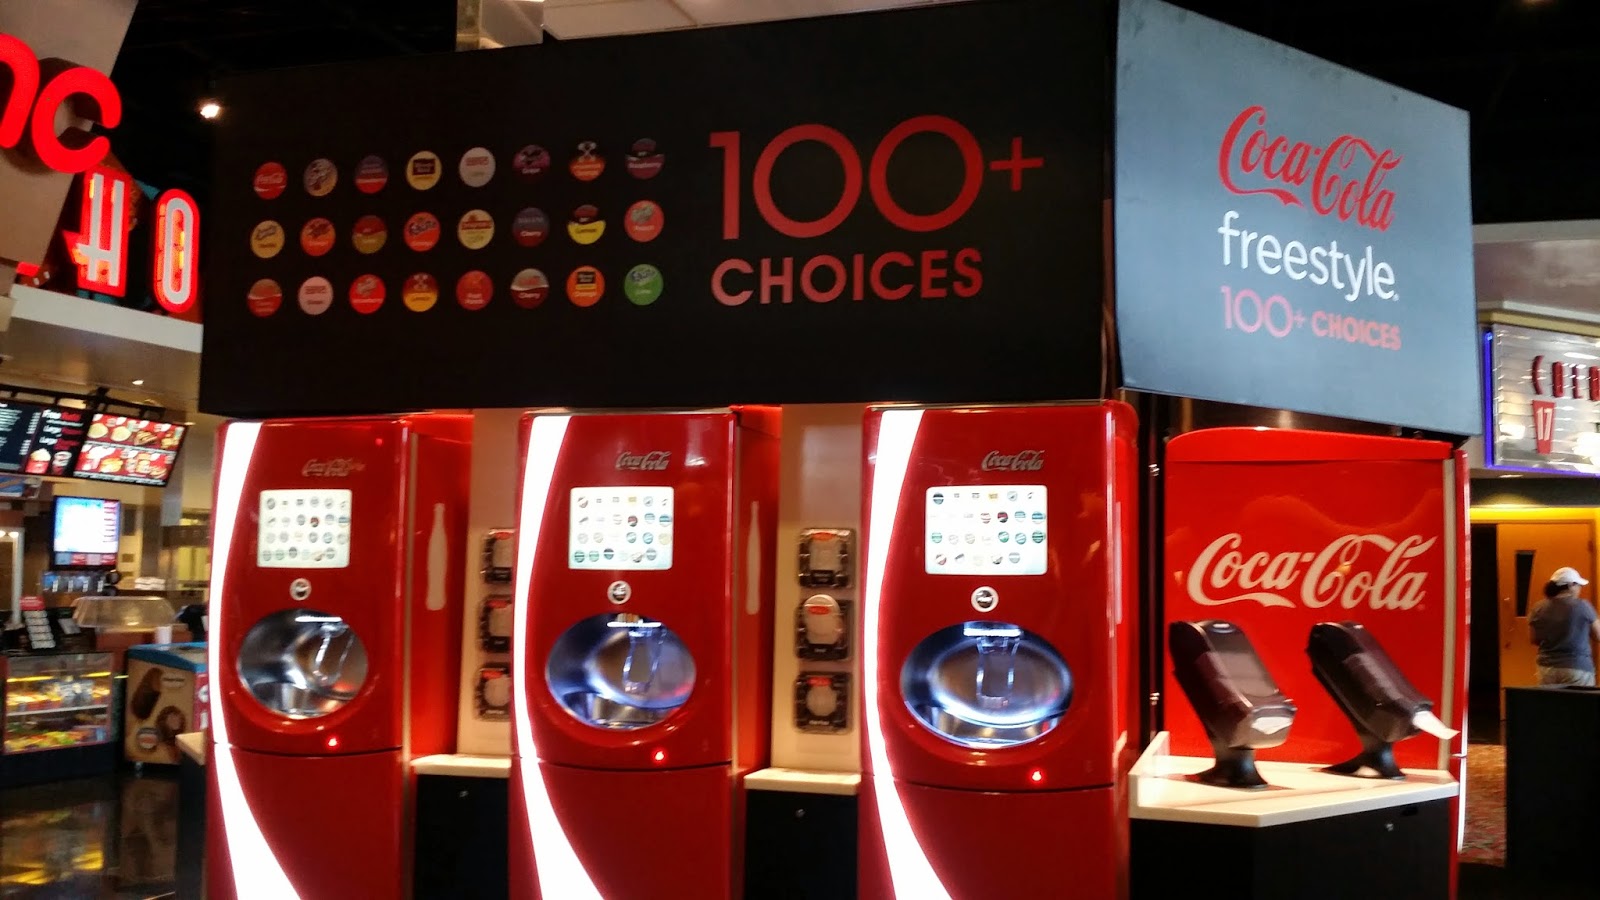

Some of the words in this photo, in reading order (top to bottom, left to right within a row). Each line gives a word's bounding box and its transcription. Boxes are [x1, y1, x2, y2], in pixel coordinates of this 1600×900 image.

[709, 114, 1045, 240] 100+
[1218, 104, 1404, 232] Coca-Cola
[711, 248, 984, 307] CHOICES
[1220, 285, 1307, 338] 100+
[1311, 310, 1402, 351] CHOICES
[615, 451, 673, 471] Coca-Cola
[981, 450, 1046, 472] Coca-Cola
[1186, 532, 1438, 611] Coca-Cola
